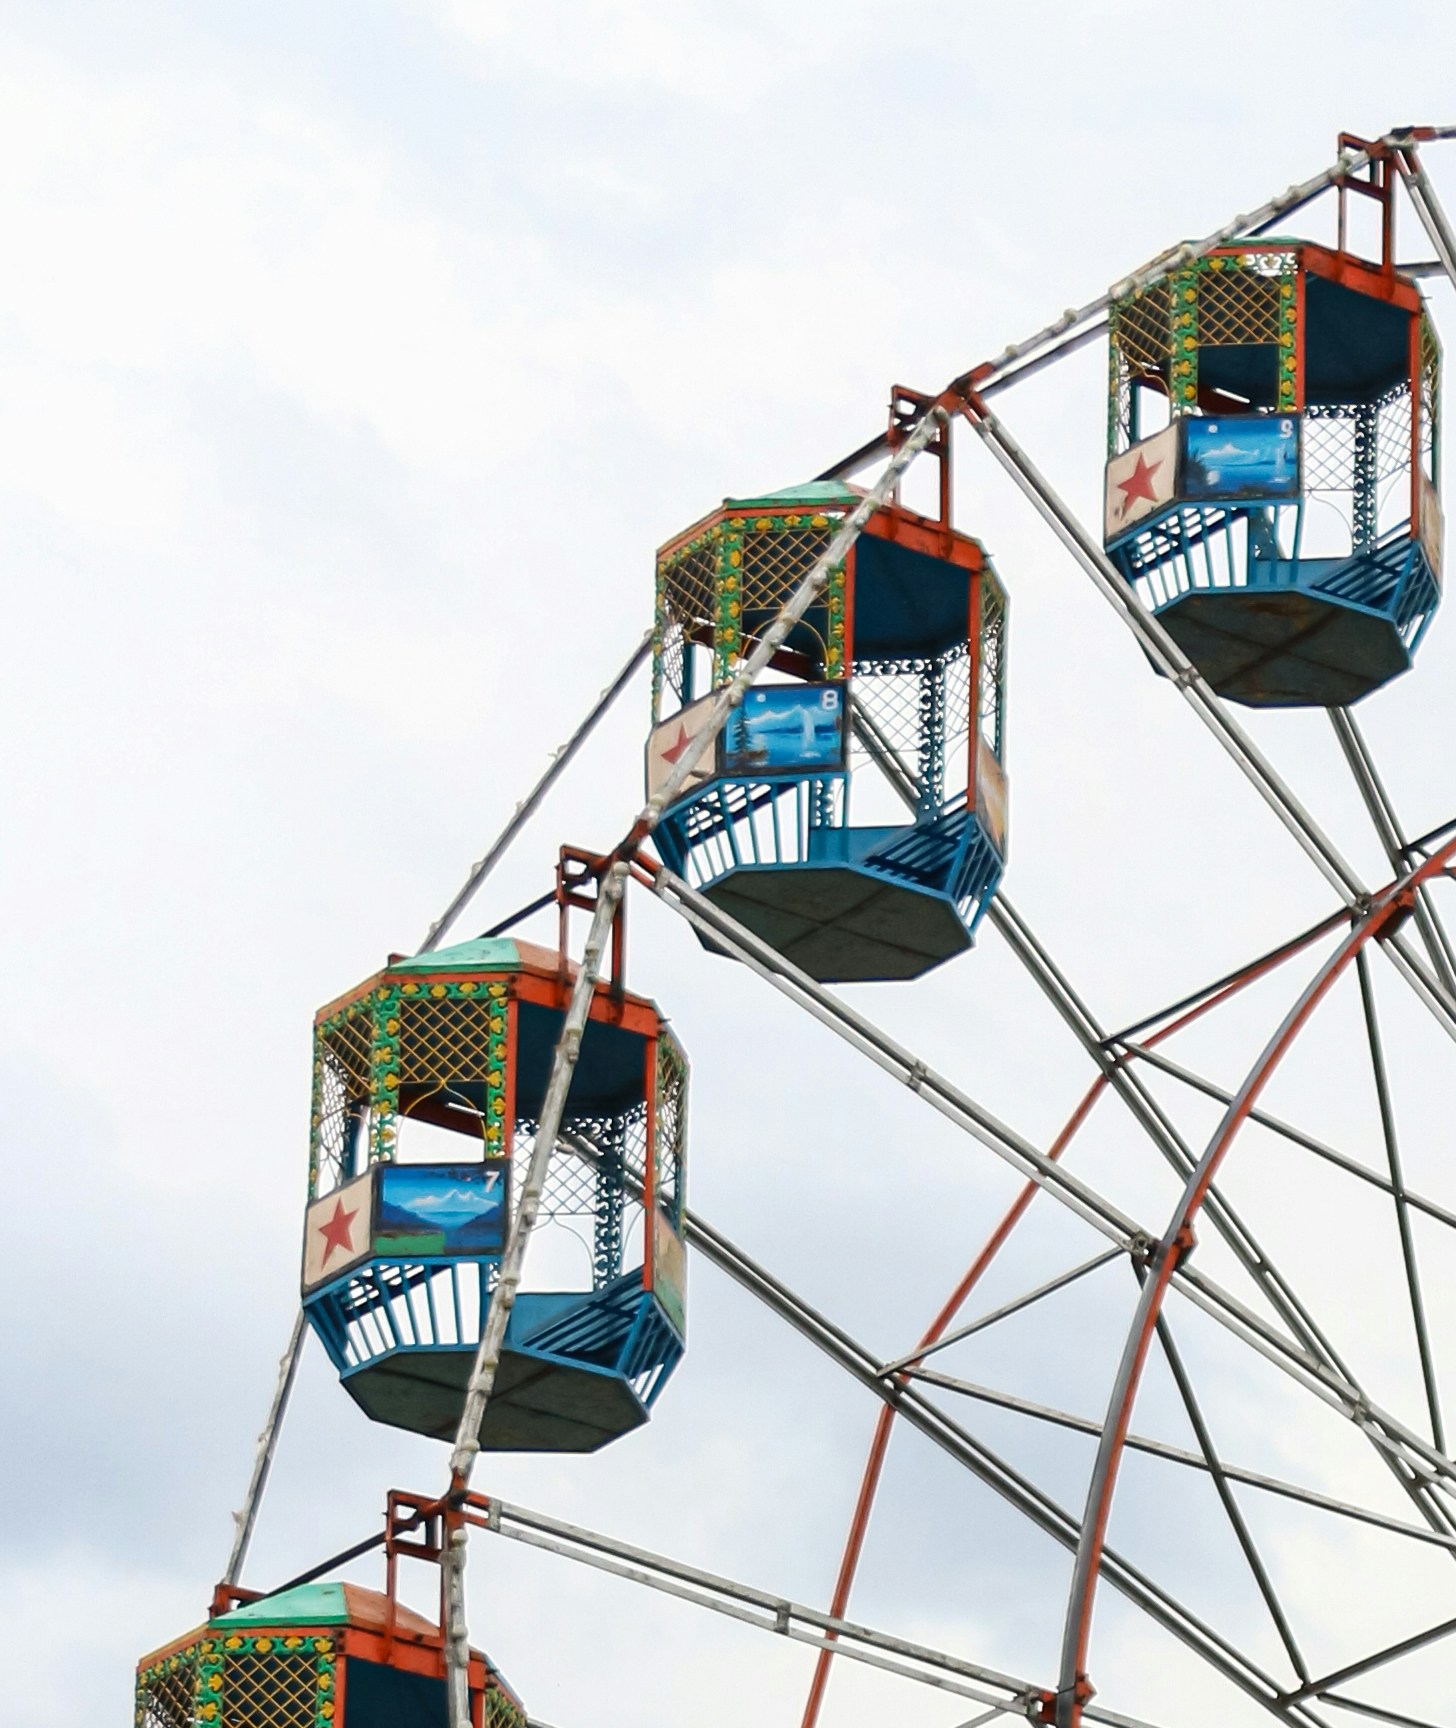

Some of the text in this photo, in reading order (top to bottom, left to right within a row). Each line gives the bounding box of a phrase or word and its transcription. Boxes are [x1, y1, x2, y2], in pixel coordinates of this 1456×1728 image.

[1280, 419, 1294, 439] 9
[821, 689, 839, 711] 8
[485, 1170, 500, 1193] 7
